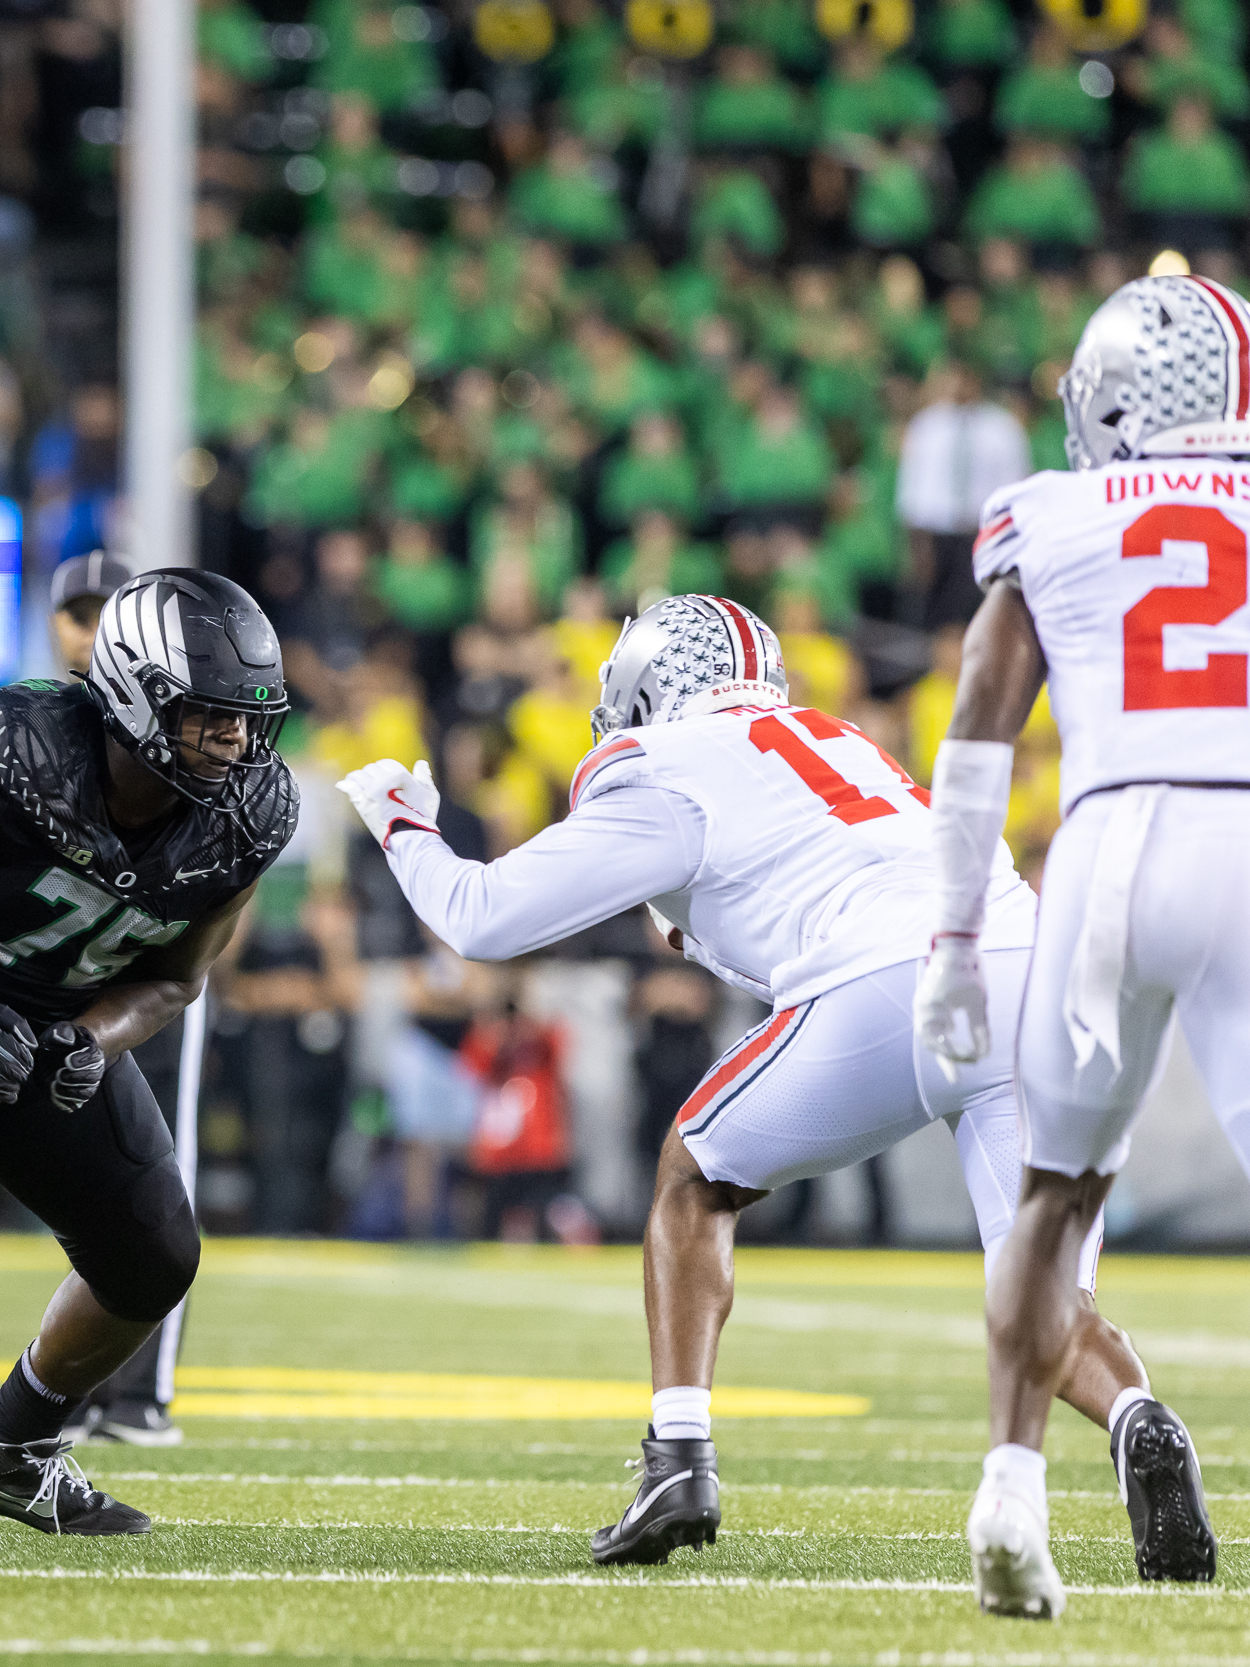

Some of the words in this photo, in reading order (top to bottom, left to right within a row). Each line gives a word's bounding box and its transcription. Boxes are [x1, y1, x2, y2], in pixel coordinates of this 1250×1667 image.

[1122, 504, 1248, 713] 2
[255, 686, 269, 701] O
[748, 707, 931, 826] 17
[114, 871, 137, 888] O
